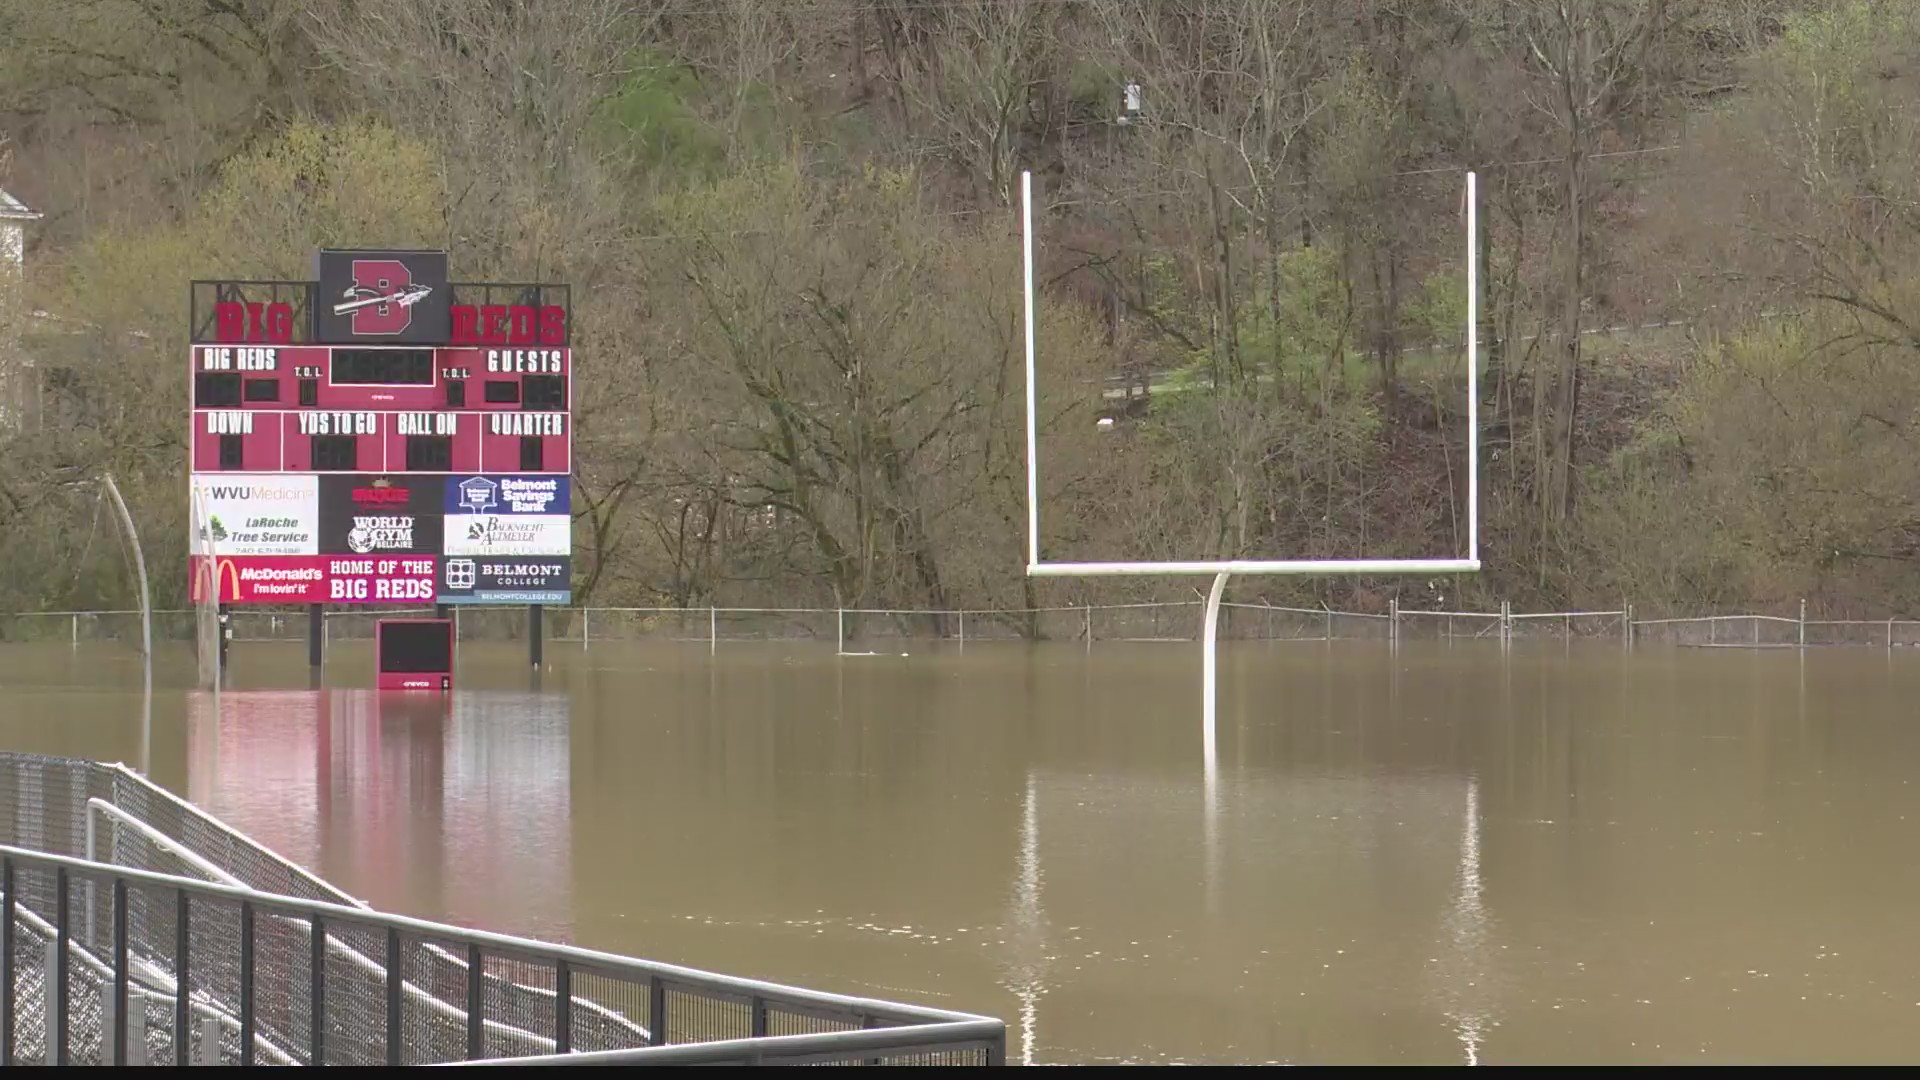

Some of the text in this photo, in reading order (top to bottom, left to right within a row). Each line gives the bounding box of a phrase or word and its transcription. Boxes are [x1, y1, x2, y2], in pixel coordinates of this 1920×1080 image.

[215, 302, 565, 344] BIG REDS
[204, 348, 275, 370] BIG REDS
[488, 350, 561, 372] GUESTS
[207, 412, 252, 434] DOWN
[299, 413, 376, 434] YDS TO GO
[398, 414, 457, 435] BALL ON
[491, 414, 562, 435] QUARTER
[501, 479, 557, 491] Belmont
[503, 491, 555, 503] Savings
[512, 502, 546, 512] Bank
[245, 518, 298, 528] LaRoche
[353, 516, 413, 529] WORLD
[231, 532, 309, 543] Tree Service
[374, 529, 413, 541] GYM
[376, 541, 413, 549] BELLAIRE
[330, 560, 374, 574] HOME
[378, 560, 398, 574] OF
[402, 560, 433, 574] THE
[481, 564, 562, 576] BELMONT
[240, 568, 323, 580] McDonald's
[497, 577, 547, 586] COLLEGE
[330, 579, 433, 599] BIG REDS
